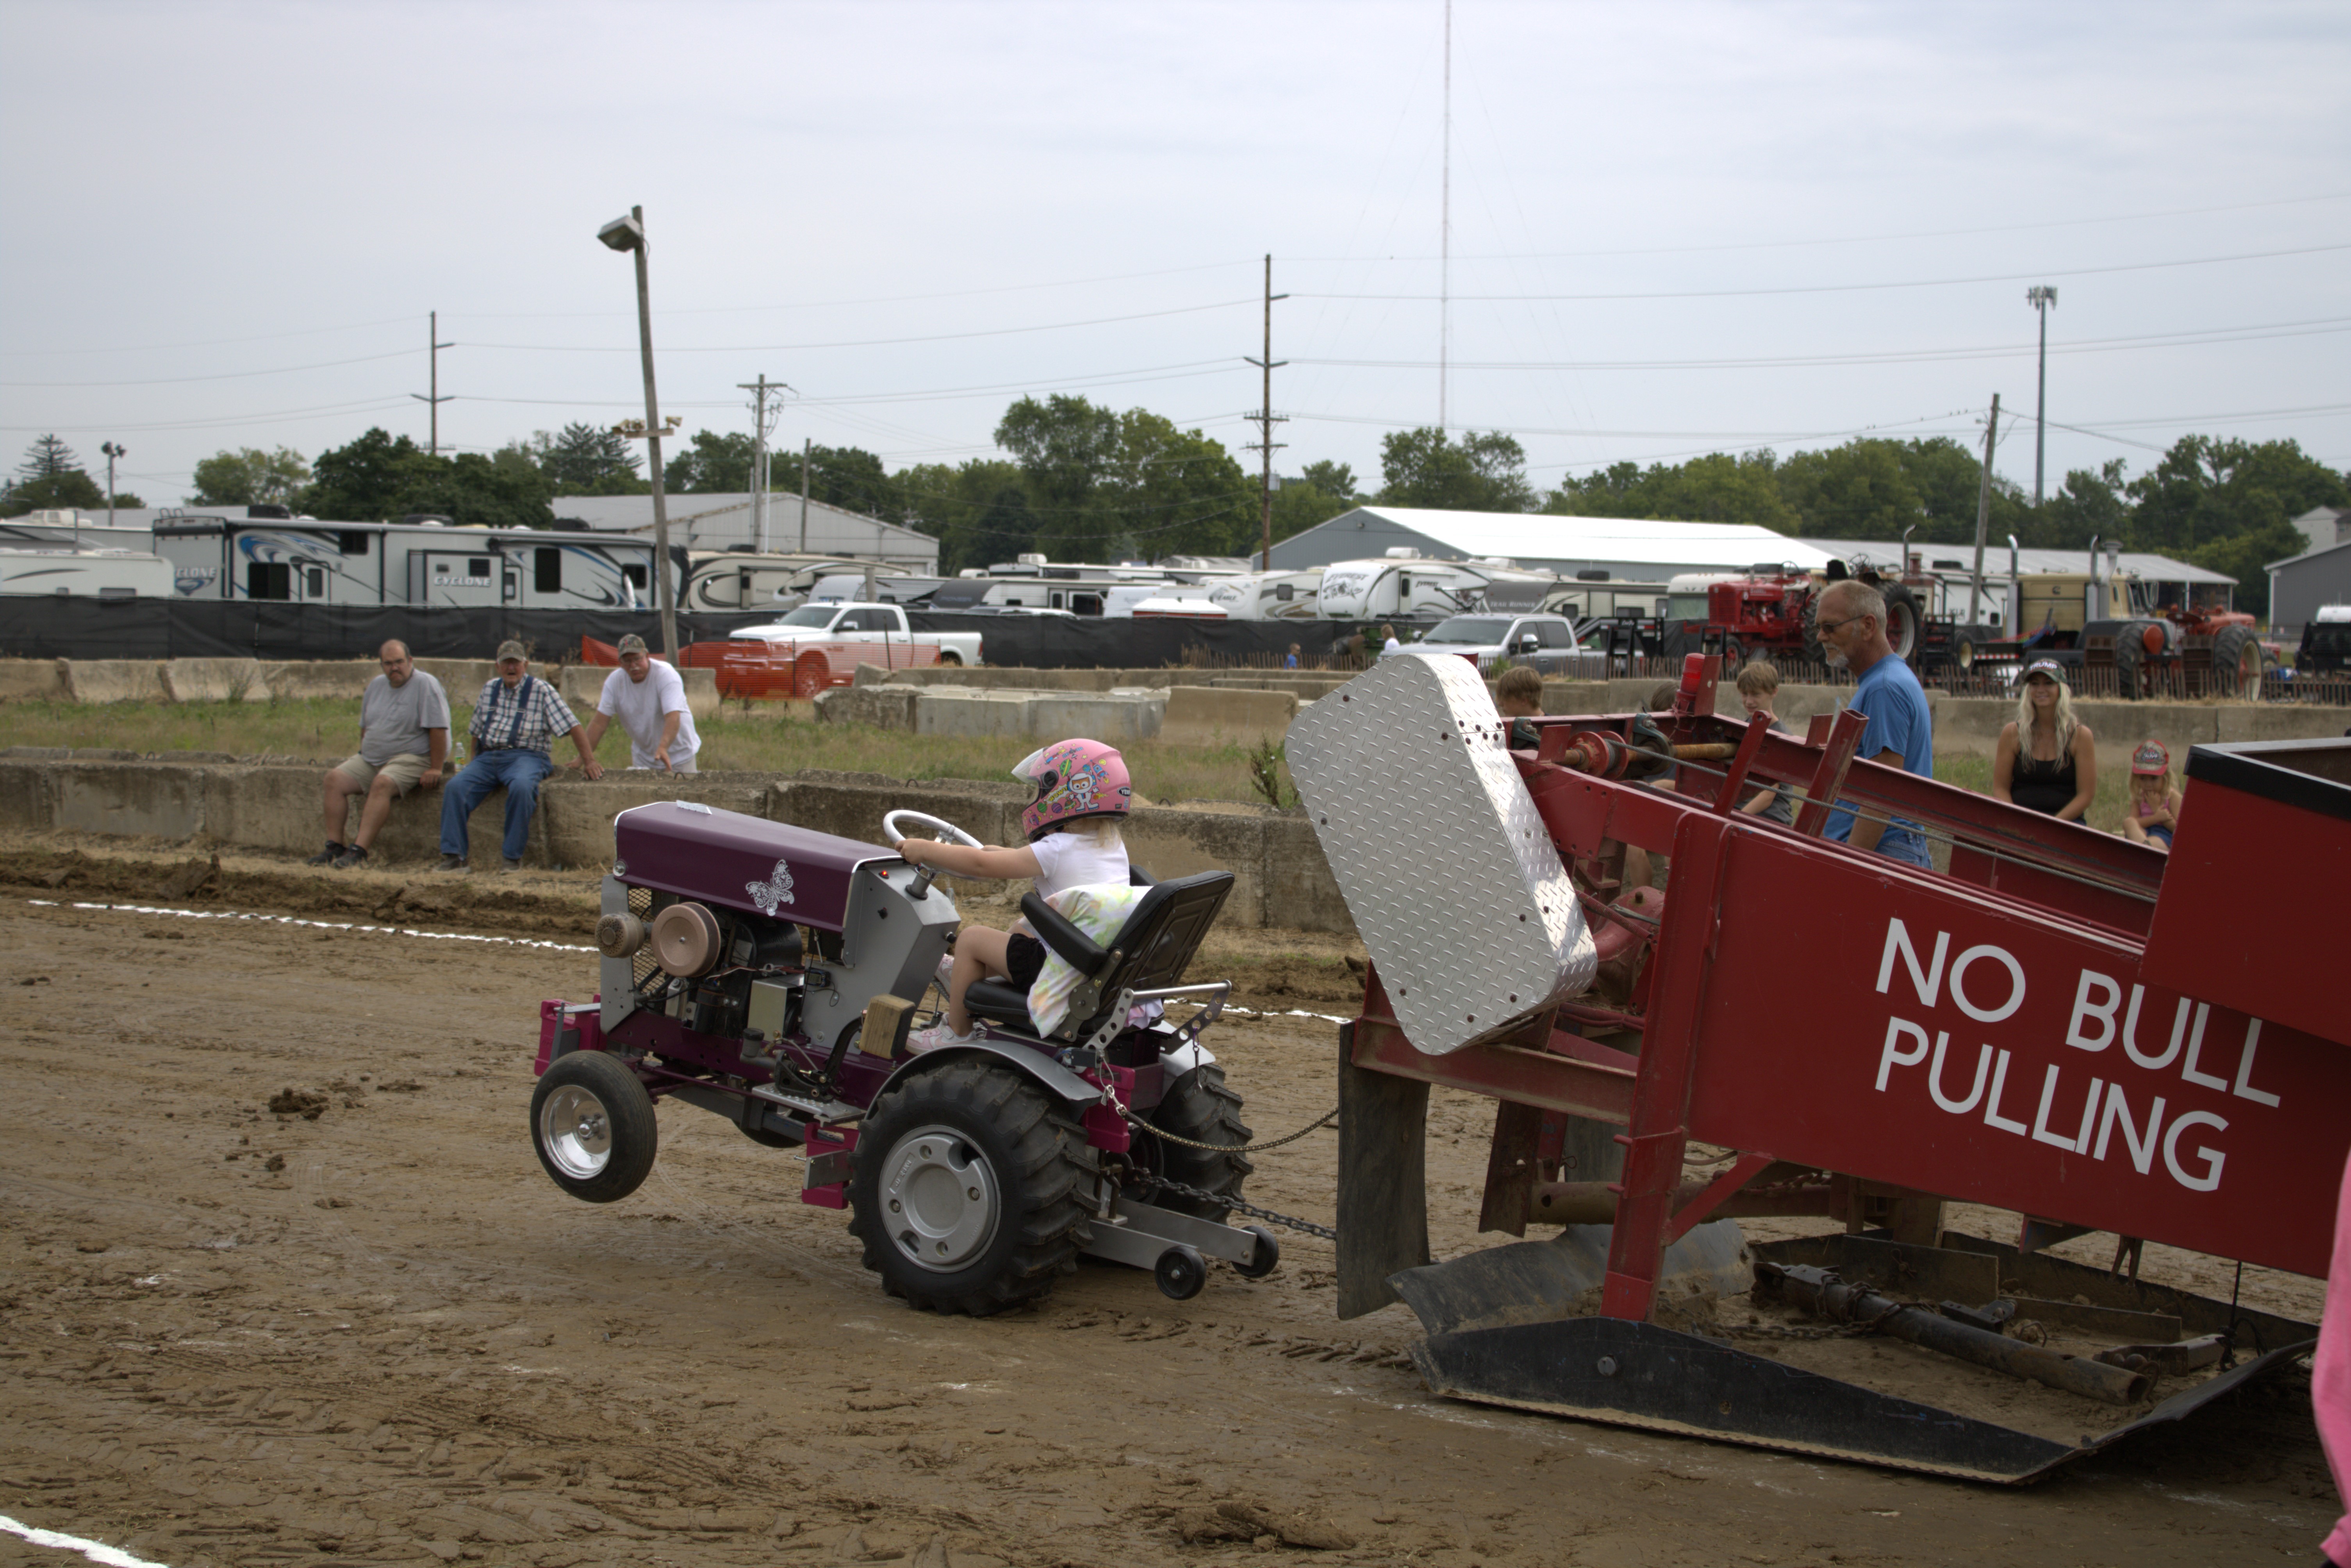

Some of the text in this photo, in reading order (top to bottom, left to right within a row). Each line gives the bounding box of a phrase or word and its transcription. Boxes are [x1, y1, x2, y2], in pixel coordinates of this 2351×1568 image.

[174, 567, 218, 578] CLONE
[434, 576, 492, 587] CYCLONE
[1325, 573, 1369, 584] EVEREST
[2029, 661, 2058, 671] TRUMP
[1876, 917, 2281, 1108] NO BULL
[1875, 1016, 2229, 1192] PULLING
